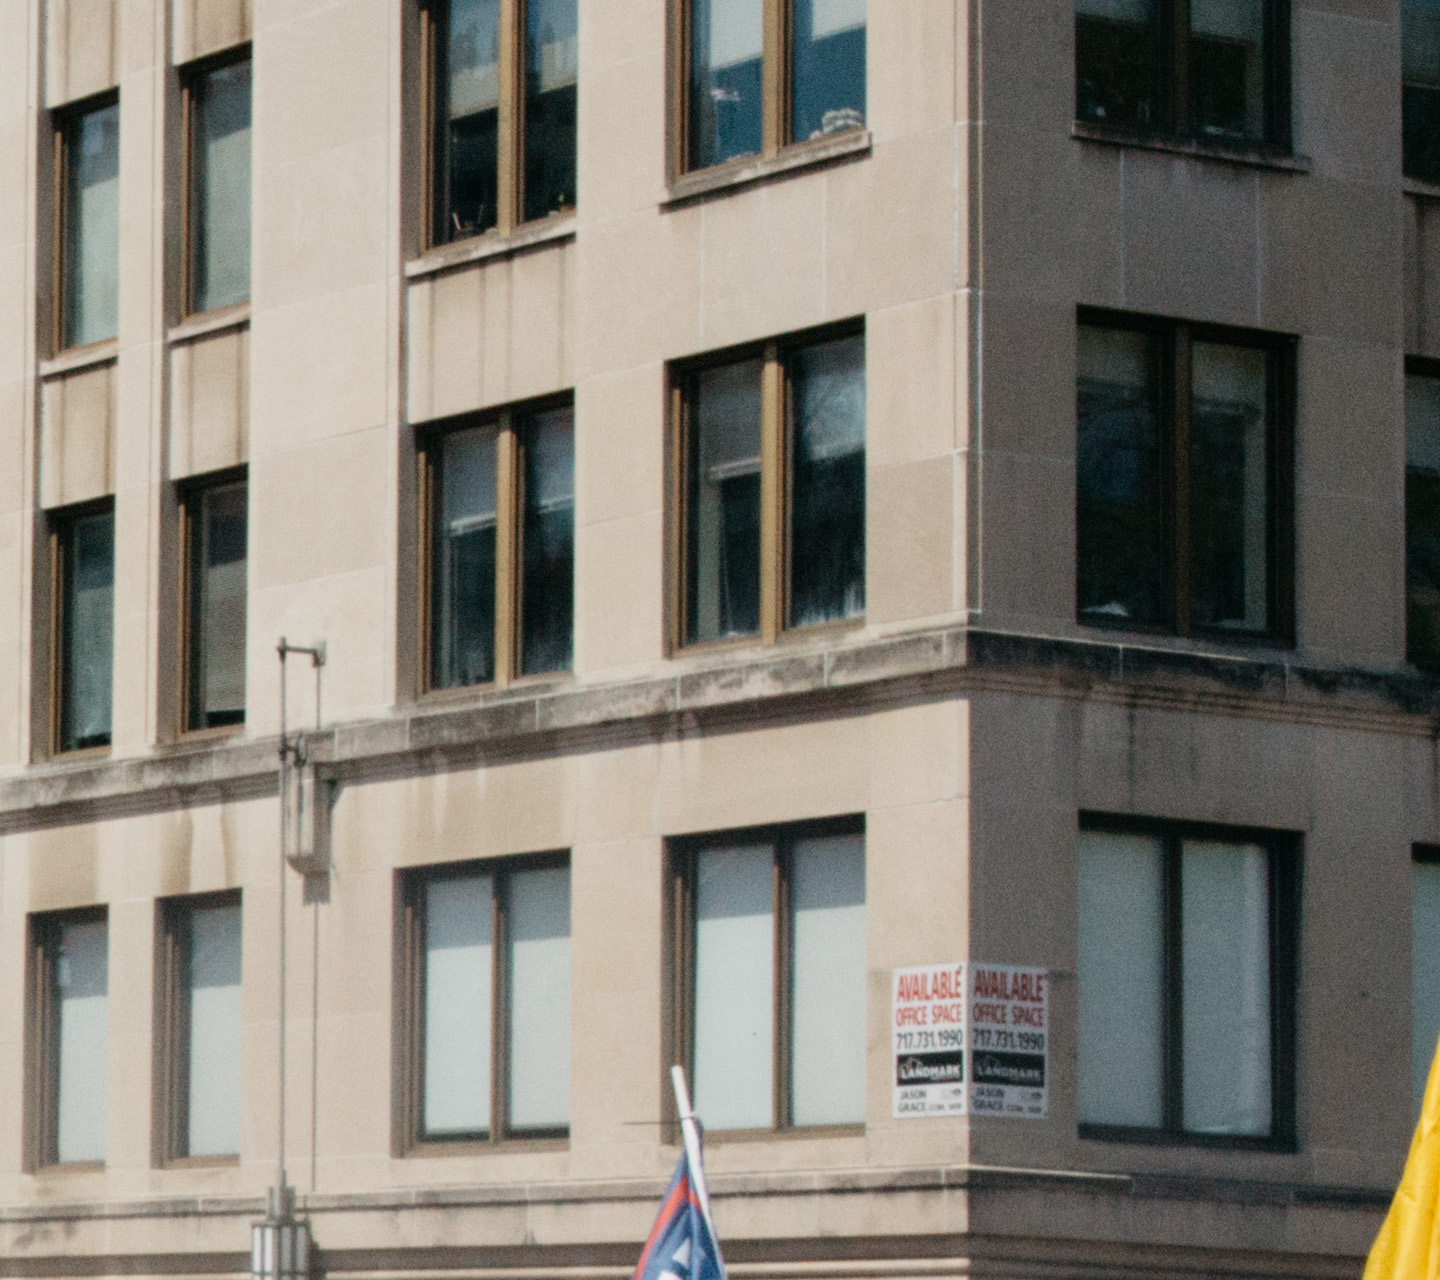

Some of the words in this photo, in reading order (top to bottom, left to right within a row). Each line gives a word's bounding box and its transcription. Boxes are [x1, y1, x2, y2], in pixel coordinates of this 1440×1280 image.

[897, 970, 962, 1003] AVAILABLE
[973, 970, 1044, 1002] AVAILABLE
[896, 1006, 927, 1027] OFFICE
[931, 1003, 962, 1025] SPACE
[973, 1003, 1007, 1025] OFFICE
[1011, 1005, 1043, 1027] SPACE
[896, 1029, 963, 1050] 717.731.1990
[973, 1027, 1045, 1050] 717.731.1990
[900, 1063, 961, 1079] LANDMARK
[898, 1101, 926, 1113] GRACE
